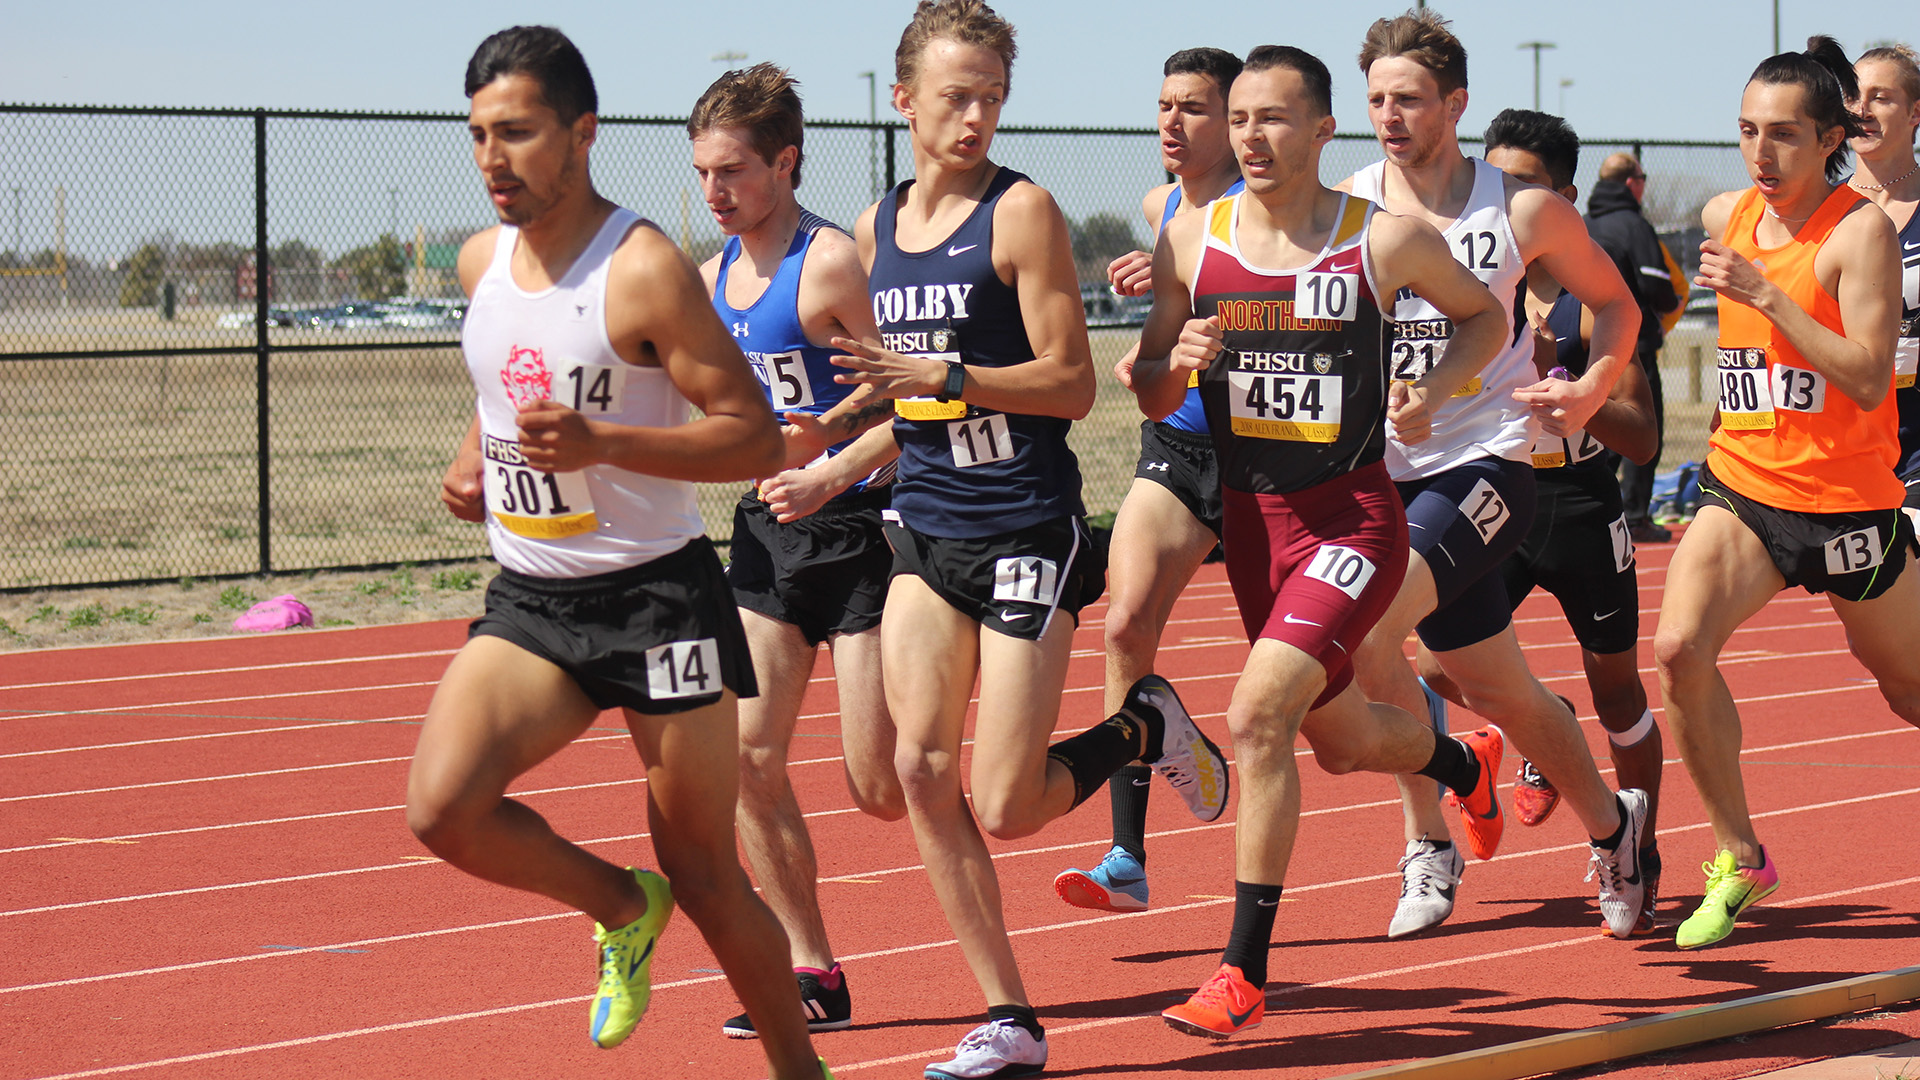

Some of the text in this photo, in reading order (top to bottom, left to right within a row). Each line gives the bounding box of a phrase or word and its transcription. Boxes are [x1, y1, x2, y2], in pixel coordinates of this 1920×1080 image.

[1459, 231, 1499, 269] 12
[874, 283, 973, 327] COLBY
[1306, 275, 1348, 318] 10
[882, 332, 929, 352] FHSU
[1238, 351, 1306, 373] FHSU
[568, 365, 614, 412] 14
[772, 355, 803, 406] 5
[1246, 376, 1324, 421] 454
[1781, 369, 1816, 411] 13
[957, 419, 999, 463] 11
[1255, 423, 1271, 435] ALEX
[1271, 424, 1301, 437] FRANCIS
[1302, 426, 1332, 439] CLASSIC
[487, 440, 529, 466] FHS
[498, 466, 571, 515] 301
[1470, 489, 1502, 537] 12
[1320, 547, 1364, 588] 10
[1833, 532, 1872, 571] 13
[1007, 558, 1043, 600] 11
[658, 644, 710, 694] 14
[1197, 757, 1219, 807] HOKA
